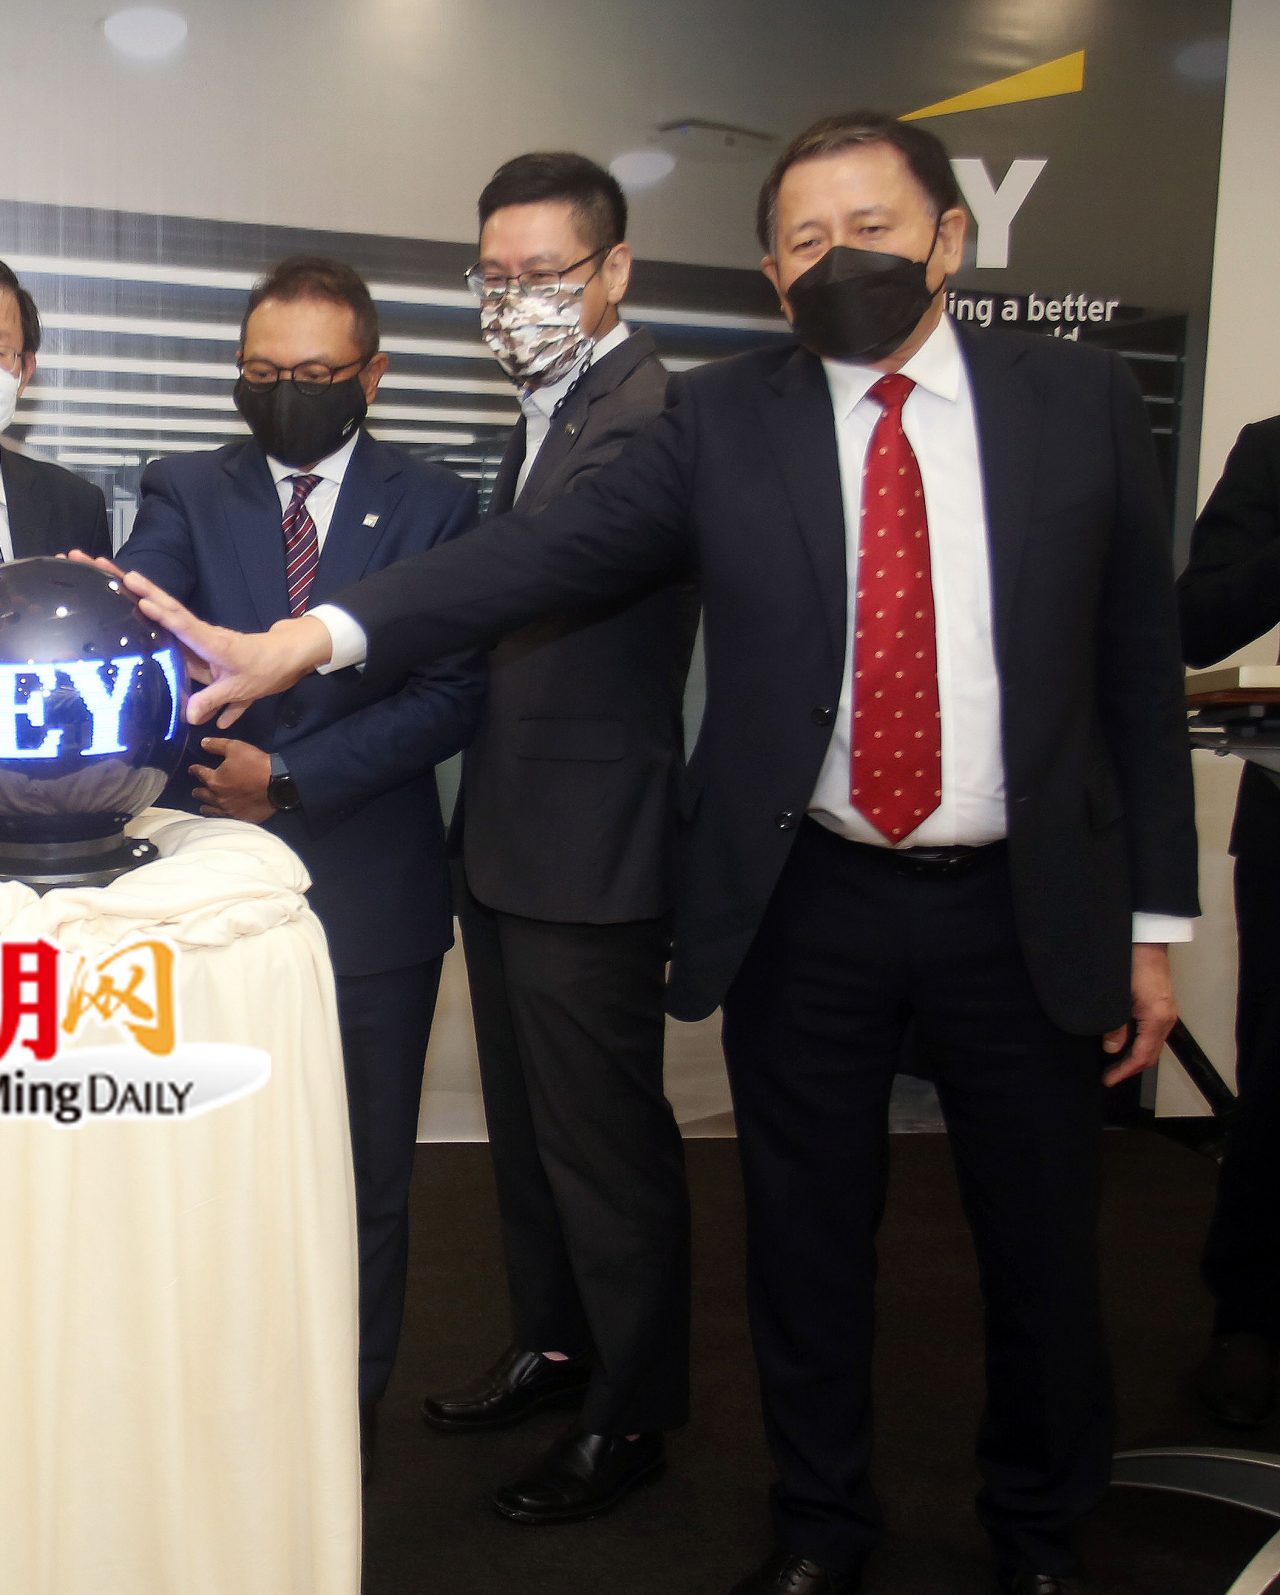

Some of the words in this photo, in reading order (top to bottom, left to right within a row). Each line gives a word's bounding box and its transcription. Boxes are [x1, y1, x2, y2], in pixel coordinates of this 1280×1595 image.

[949, 159, 1048, 269] Y
[943, 291, 993, 328] ing
[1001, 300, 1019, 322] a
[1027, 292, 1120, 323] better
